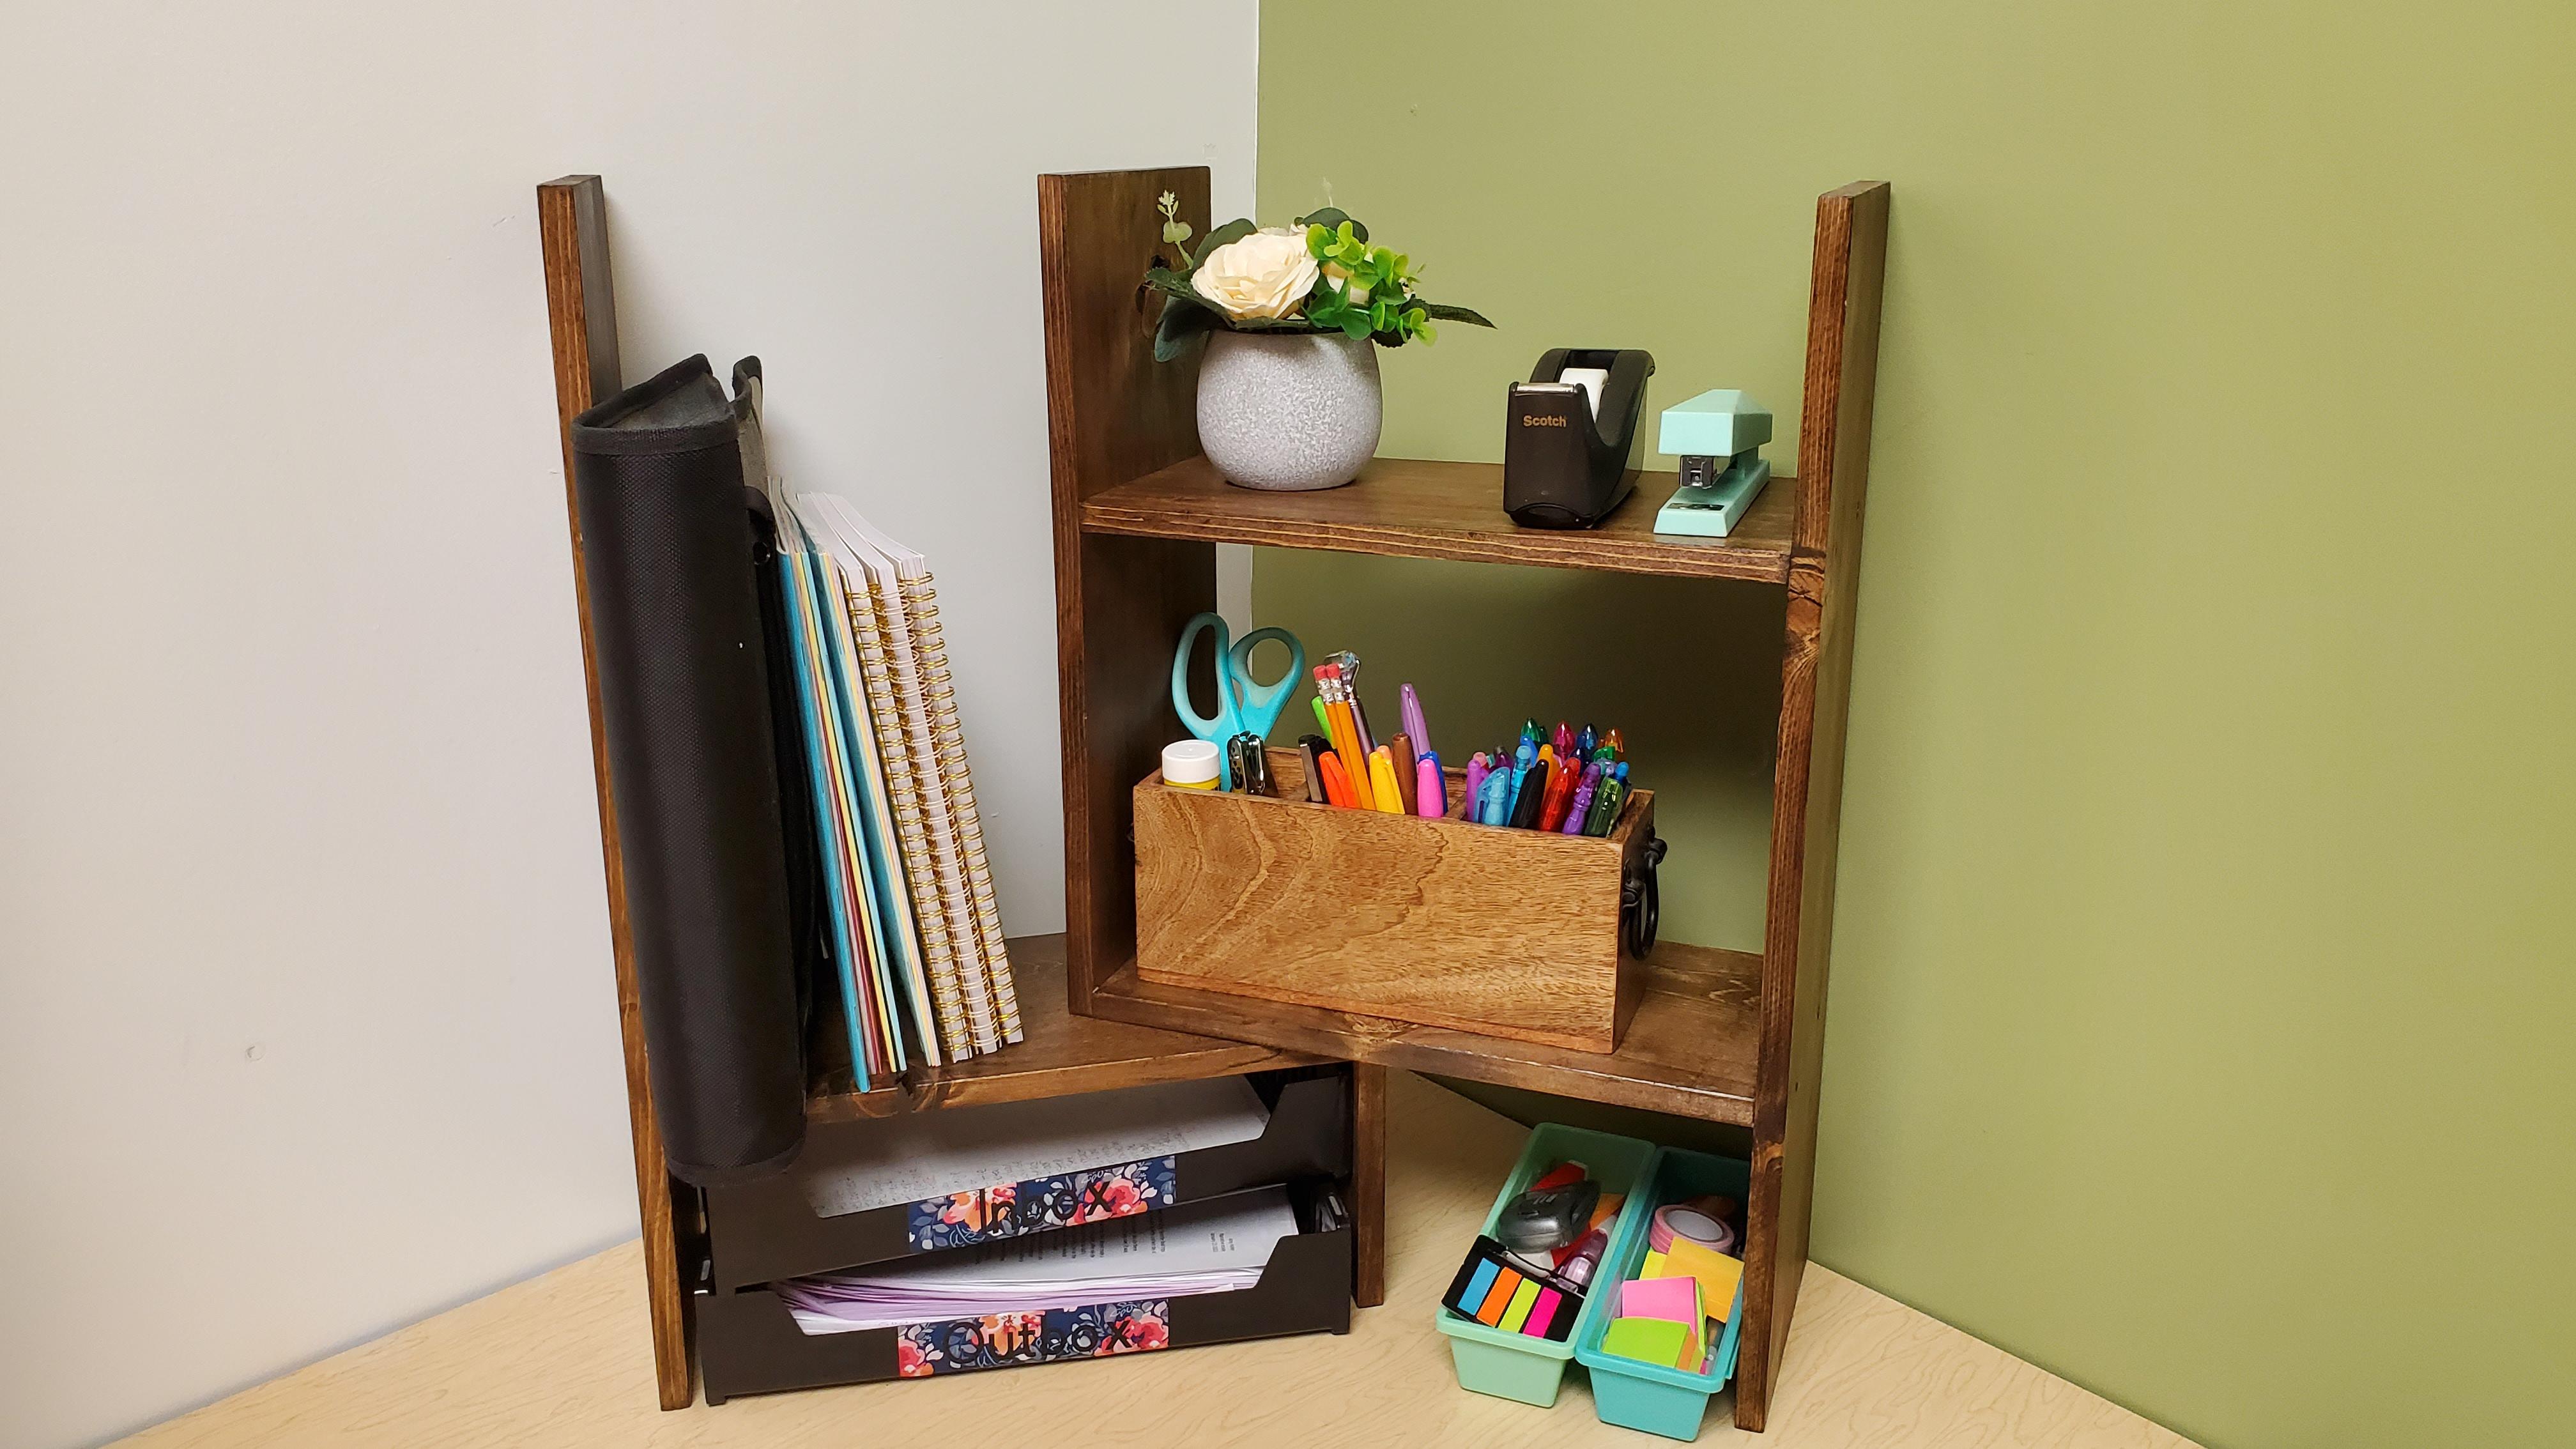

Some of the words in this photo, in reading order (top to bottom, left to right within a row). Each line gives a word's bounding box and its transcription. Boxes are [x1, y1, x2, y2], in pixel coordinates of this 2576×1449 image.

[1523, 415, 1567, 427] Scotch
[979, 1181, 1112, 1234] Inbox
[945, 1315, 1133, 1363] Outbox
